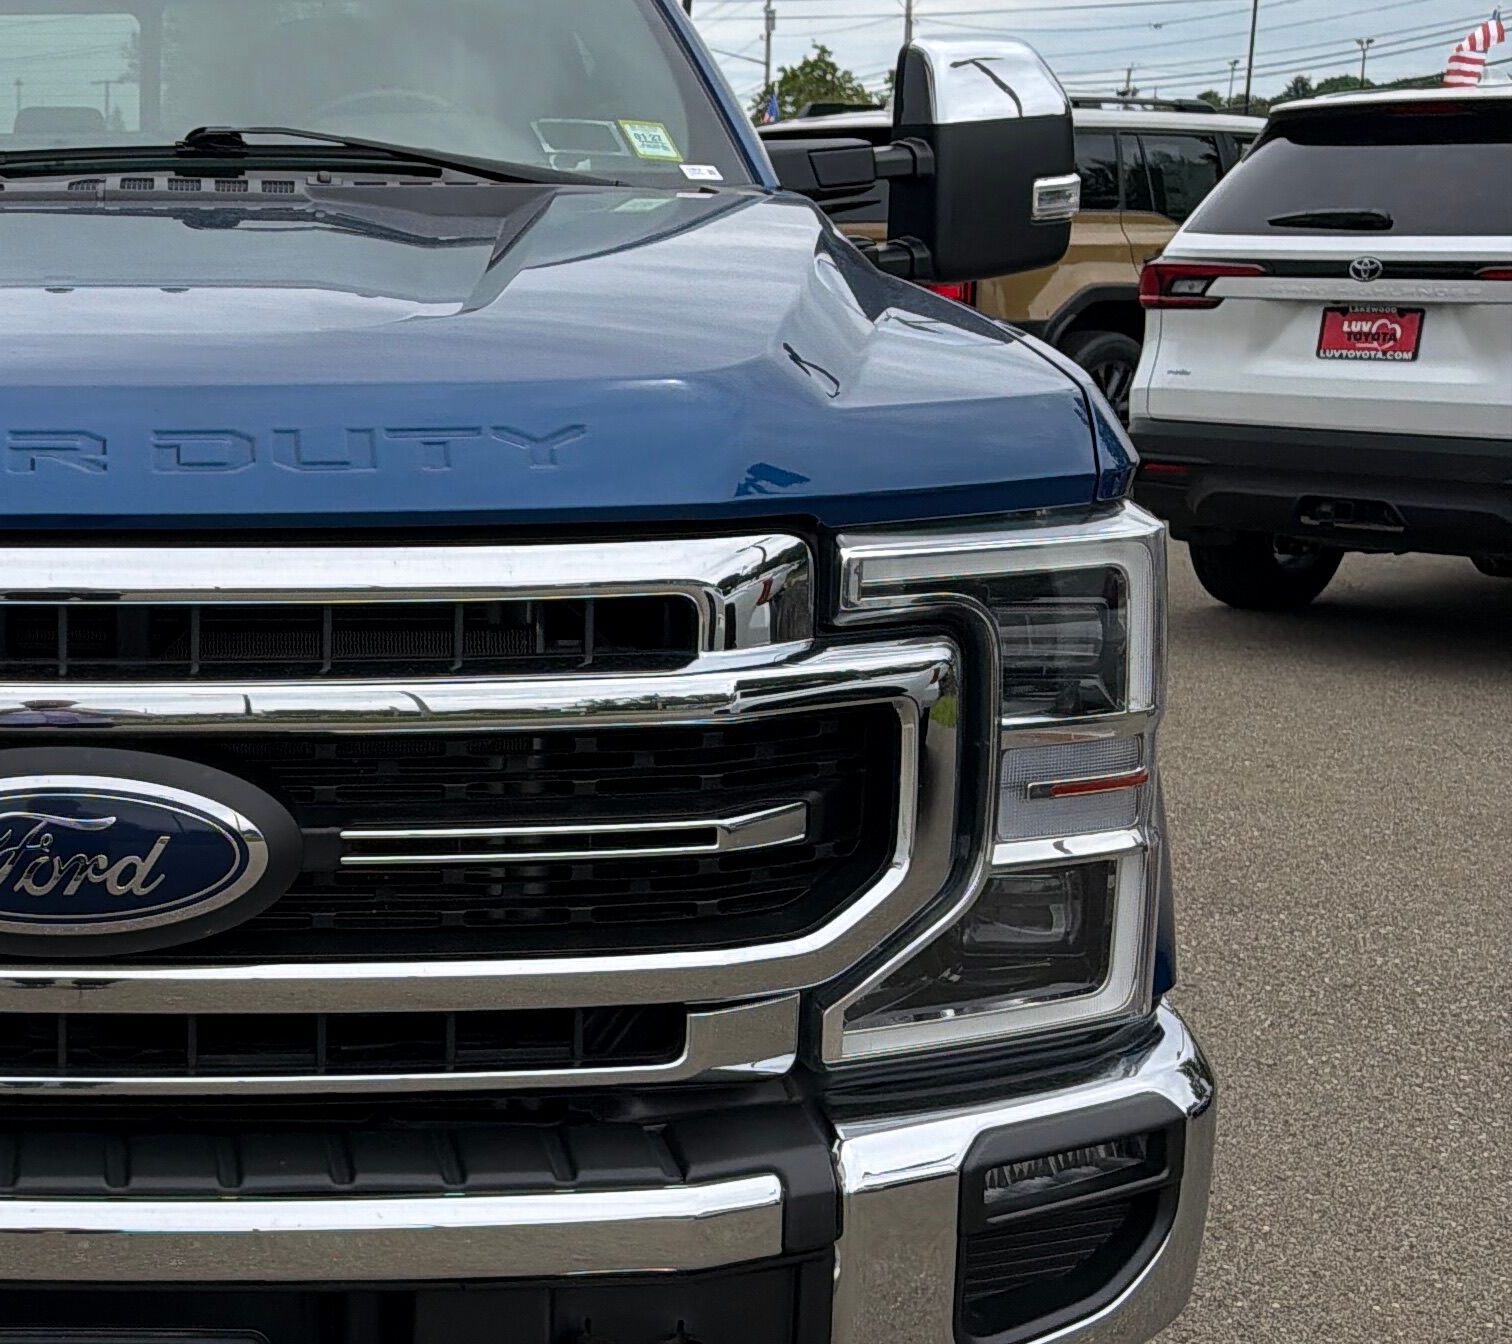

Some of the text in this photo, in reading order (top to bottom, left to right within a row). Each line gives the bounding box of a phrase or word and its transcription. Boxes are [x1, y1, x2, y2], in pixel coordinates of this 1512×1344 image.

[1349, 304, 1398, 314] LAKEWOOD
[1342, 320, 1373, 332] LUV
[1346, 331, 1398, 343] TOYOTA
[1319, 348, 1413, 360] LUVTOYOTA.COM
[151, 423, 588, 475] DUTY
